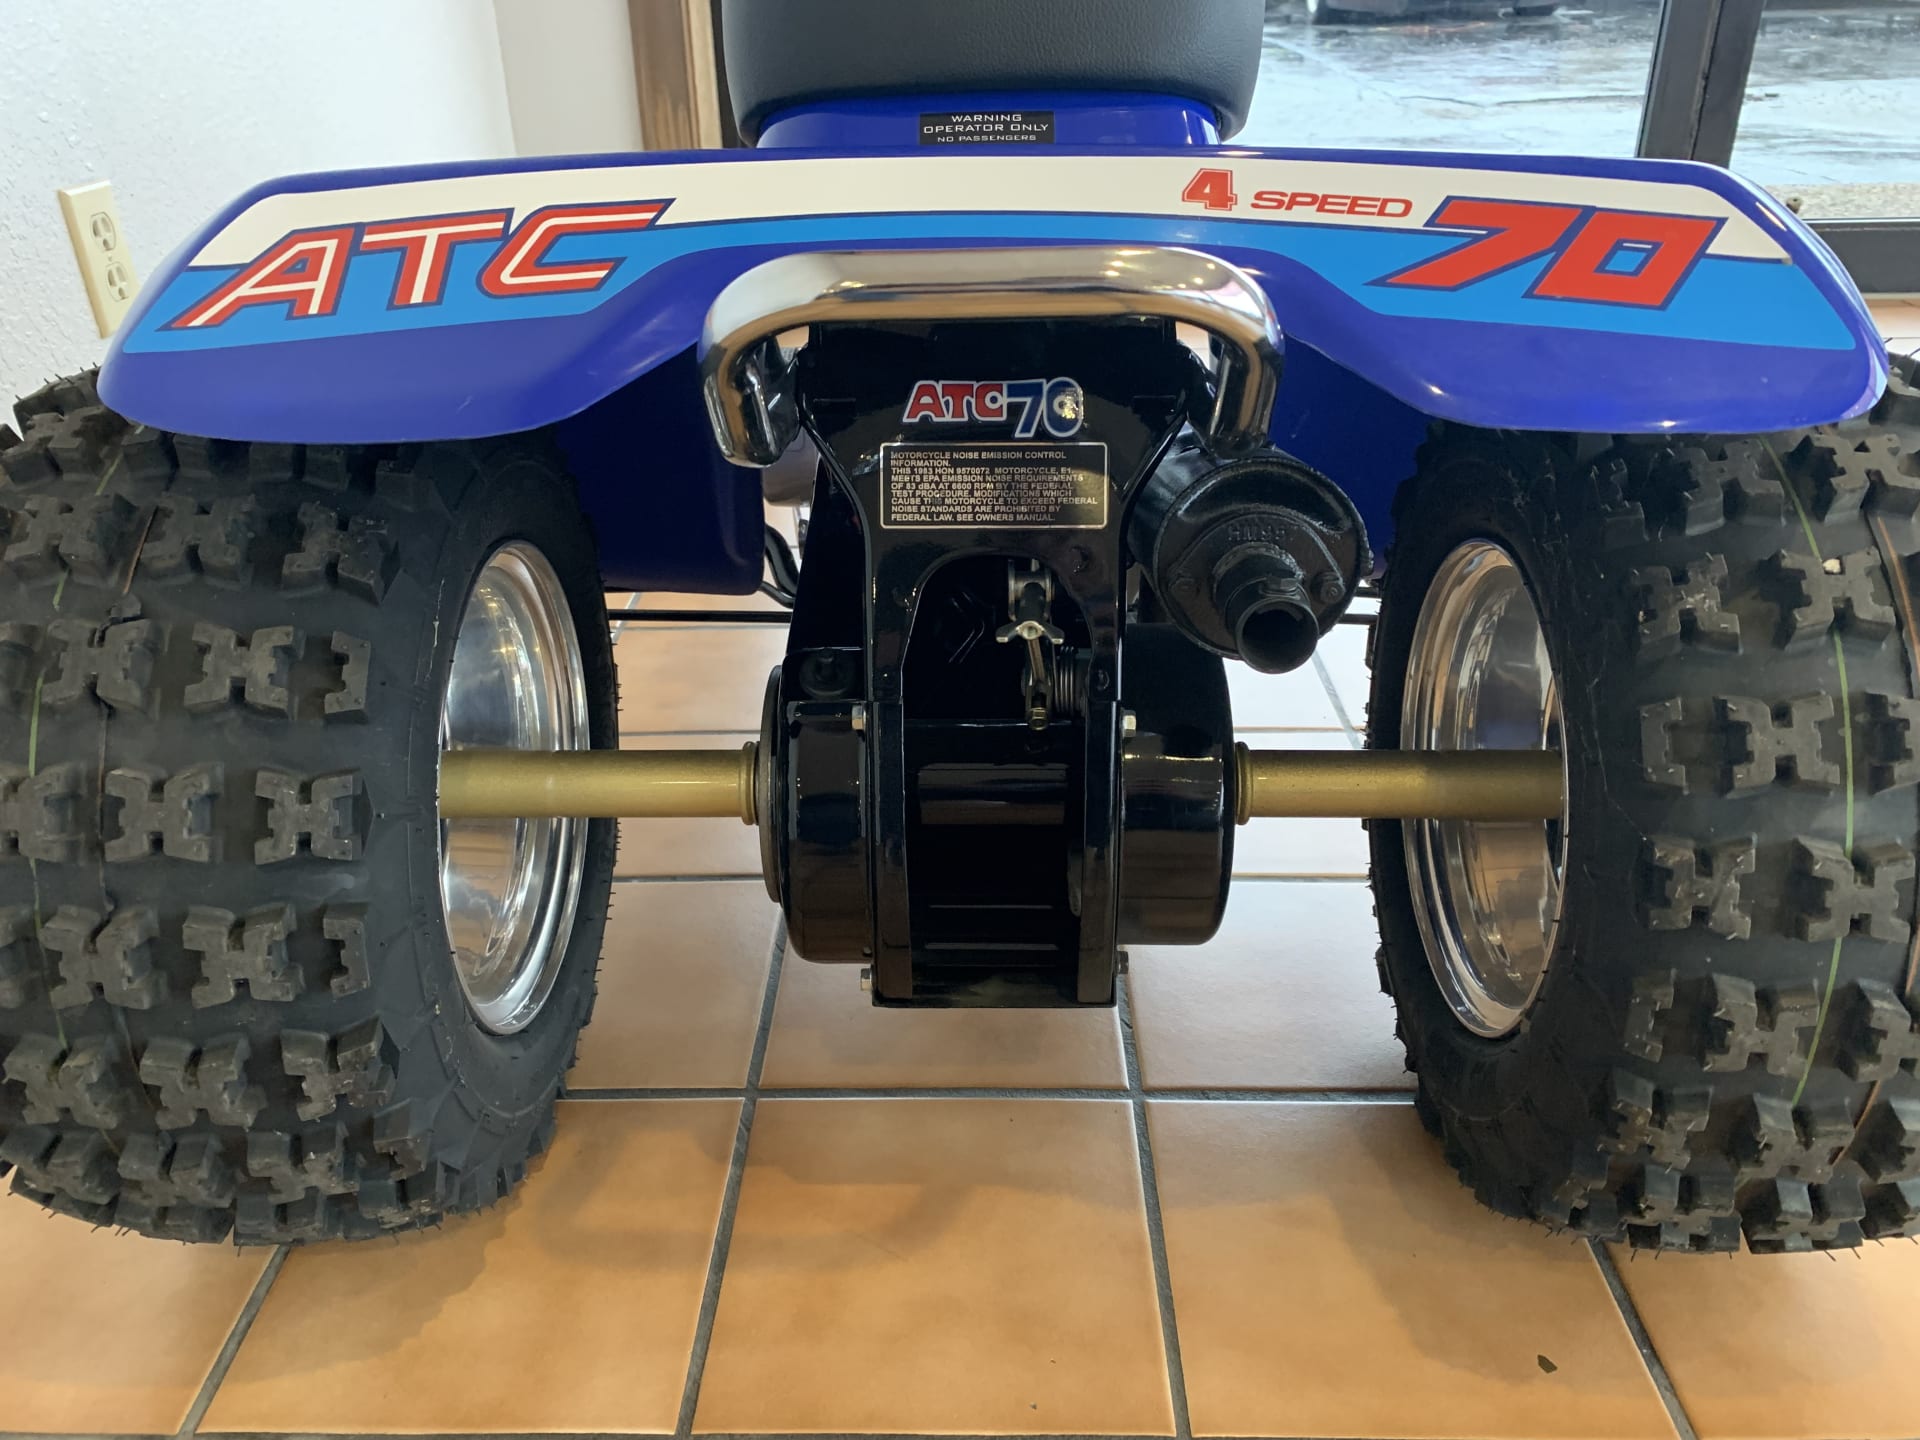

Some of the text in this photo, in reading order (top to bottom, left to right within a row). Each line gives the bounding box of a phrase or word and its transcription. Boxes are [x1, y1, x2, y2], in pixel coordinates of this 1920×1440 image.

[923, 124, 1004, 134] OPERATOR
[951, 114, 1022, 122] WARNING
[958, 134, 1037, 142] PASSENGERS
[1181, 168, 1413, 218] 4 SPEED
[155, 198, 677, 332] ATC
[1363, 195, 1729, 311] 70
